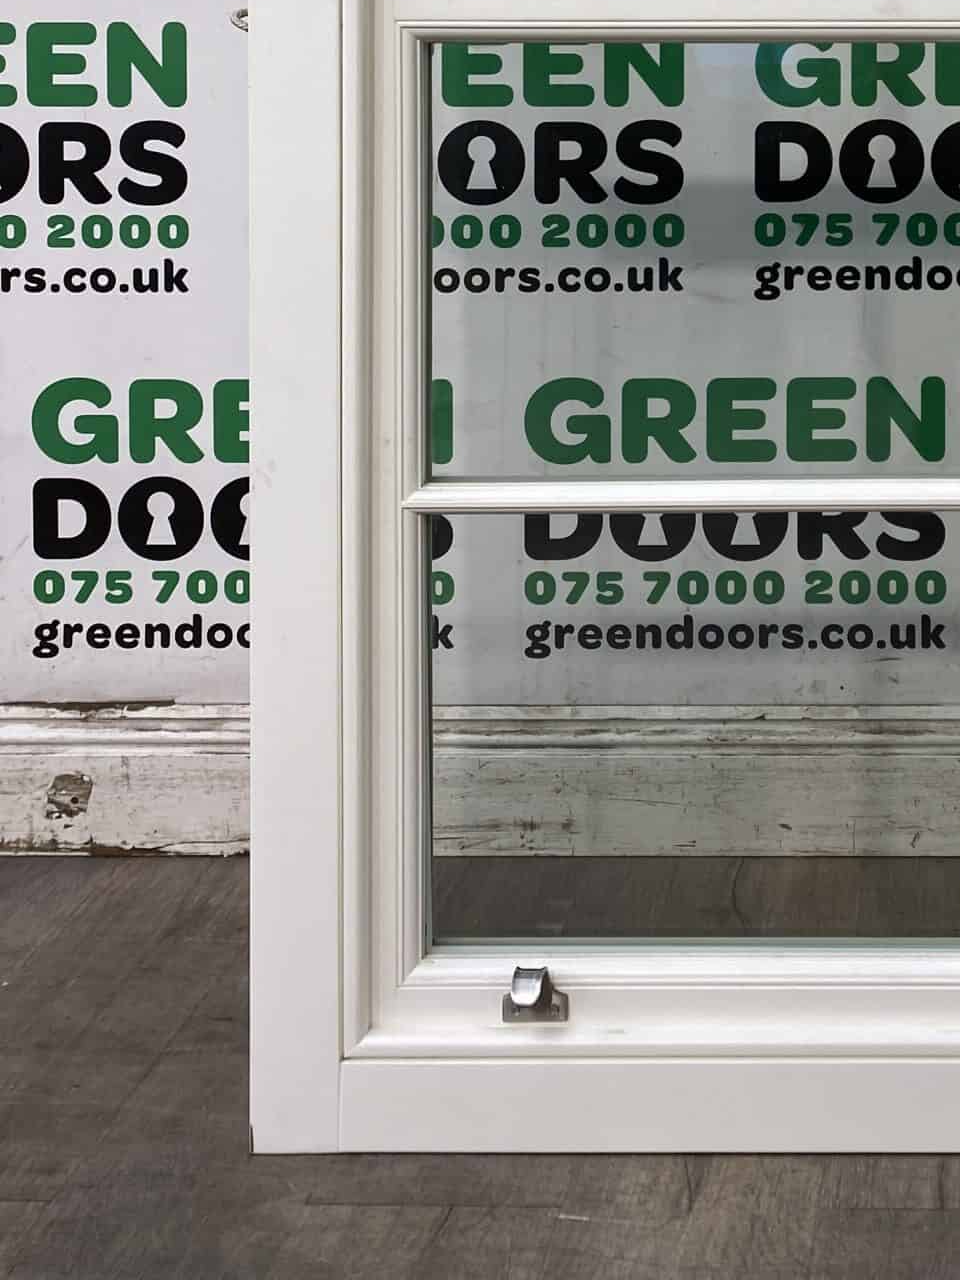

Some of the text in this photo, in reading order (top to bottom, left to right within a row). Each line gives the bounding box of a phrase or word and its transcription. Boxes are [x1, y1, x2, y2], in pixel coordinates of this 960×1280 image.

[0, 22, 187, 108] EN
[437, 120, 684, 205] ORS
[47, 214, 189, 249] 2000
[542, 214, 685, 248] 2000
[755, 213, 853, 247] 075
[524, 376, 946, 464] GREEN
[524, 512, 946, 561] DOORS
[34, 570, 133, 604] 075
[525, 570, 947, 605] 075 7000 2000
[524, 615, 946, 658] greendoors.co.uk
